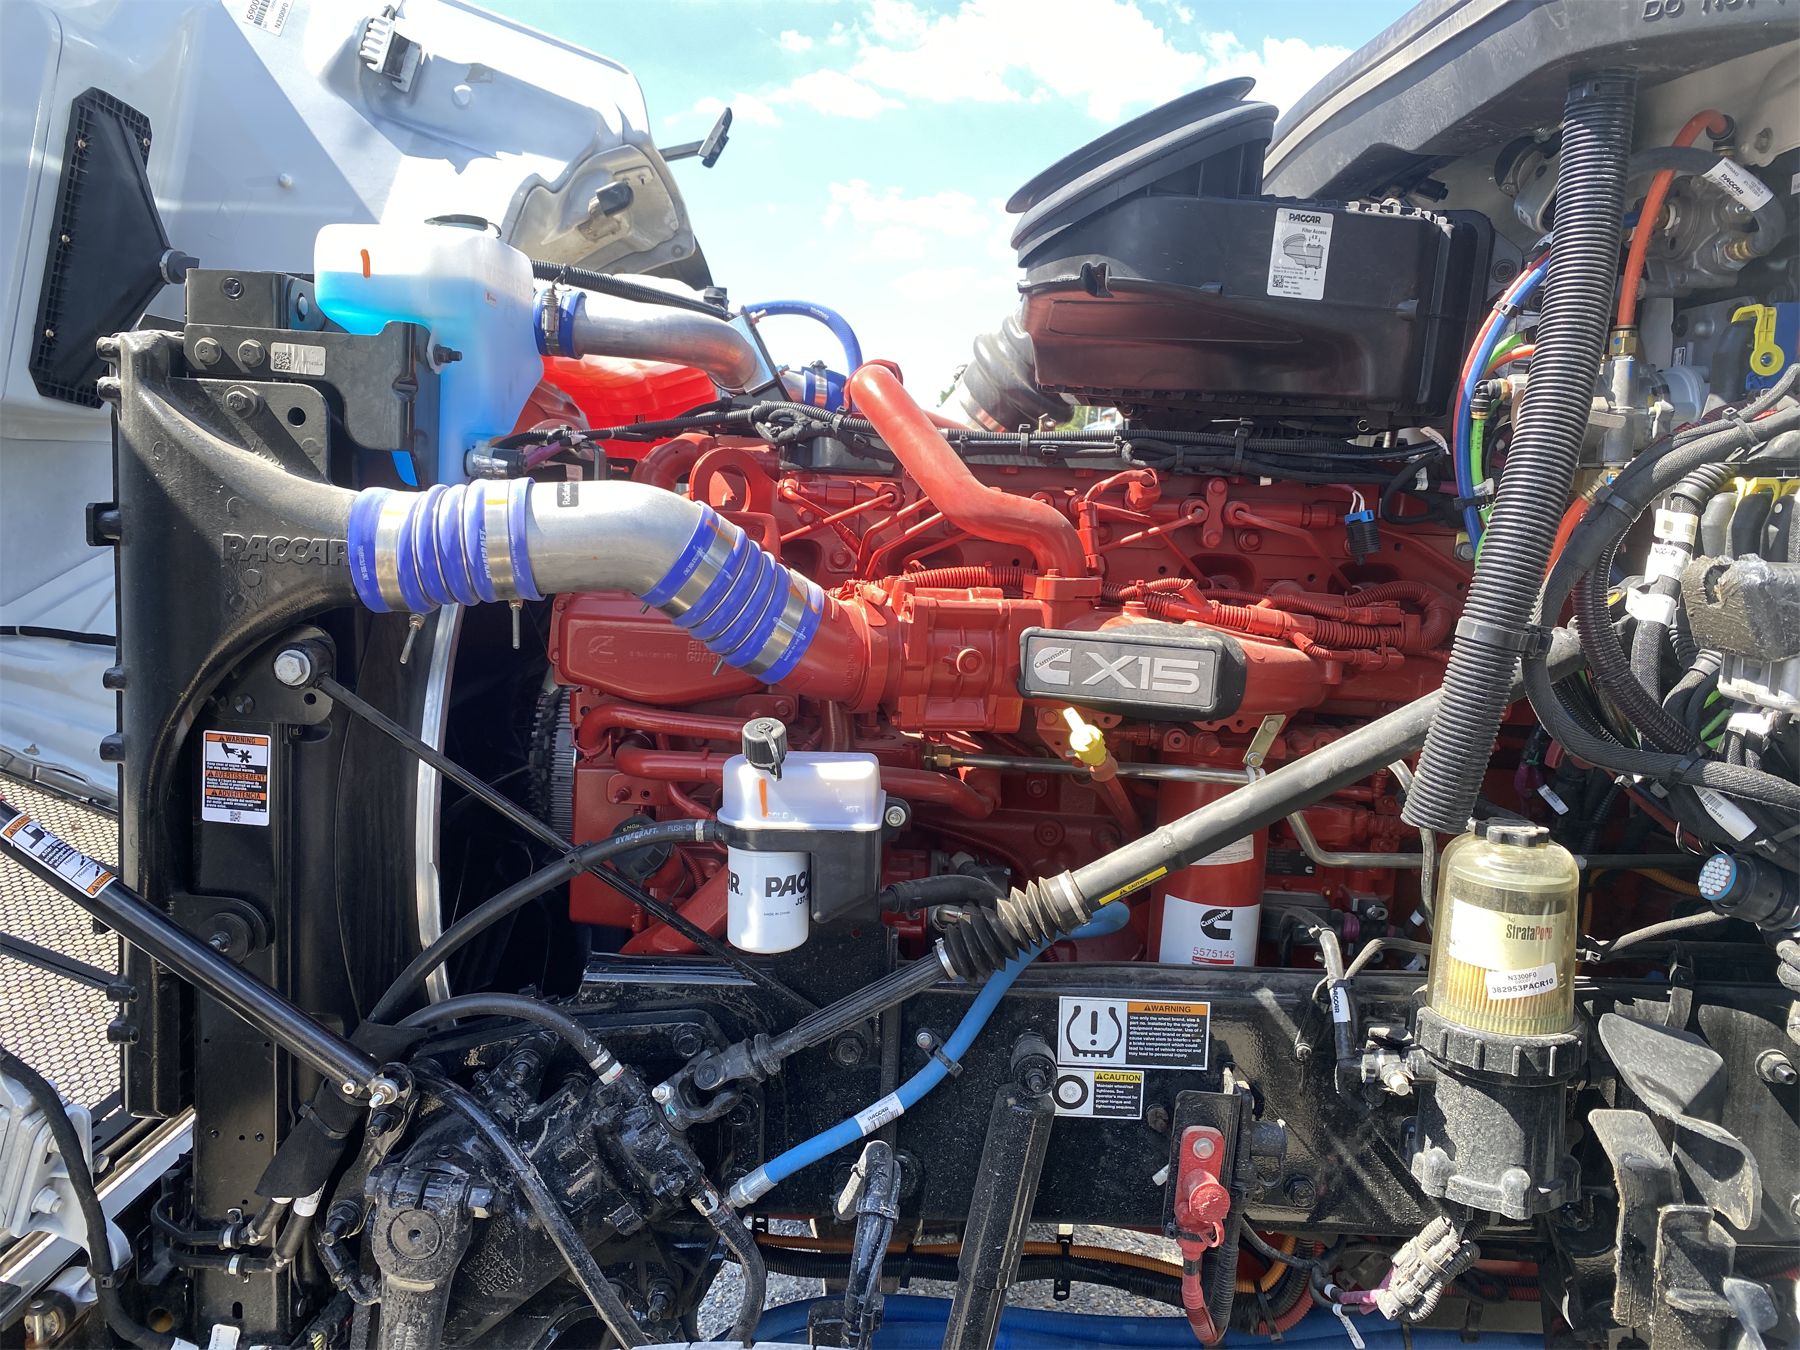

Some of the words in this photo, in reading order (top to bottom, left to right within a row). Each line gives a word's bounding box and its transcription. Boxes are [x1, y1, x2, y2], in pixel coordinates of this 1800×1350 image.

[1720, 173, 1744, 195] PACCAR
[1288, 213, 1322, 224] PACCAR
[222, 532, 350, 567] PACCAR
[1034, 647, 1070, 669] Cummins
[1081, 651, 1200, 694] X15
[226, 736, 256, 744] WARNING
[215, 771, 265, 780] AVERTISSEMENT
[218, 790, 261, 799] ADVERTENCIA
[765, 870, 808, 898] PAC
[1127, 877, 1148, 891] CAUTION
[1200, 909, 1232, 928] Cummins
[1192, 946, 1235, 959] 5575143
[1491, 977, 1554, 994] 382953PACR10
[1151, 1004, 1191, 1013] WARNING
[1103, 1073, 1141, 1081] CAUTION
